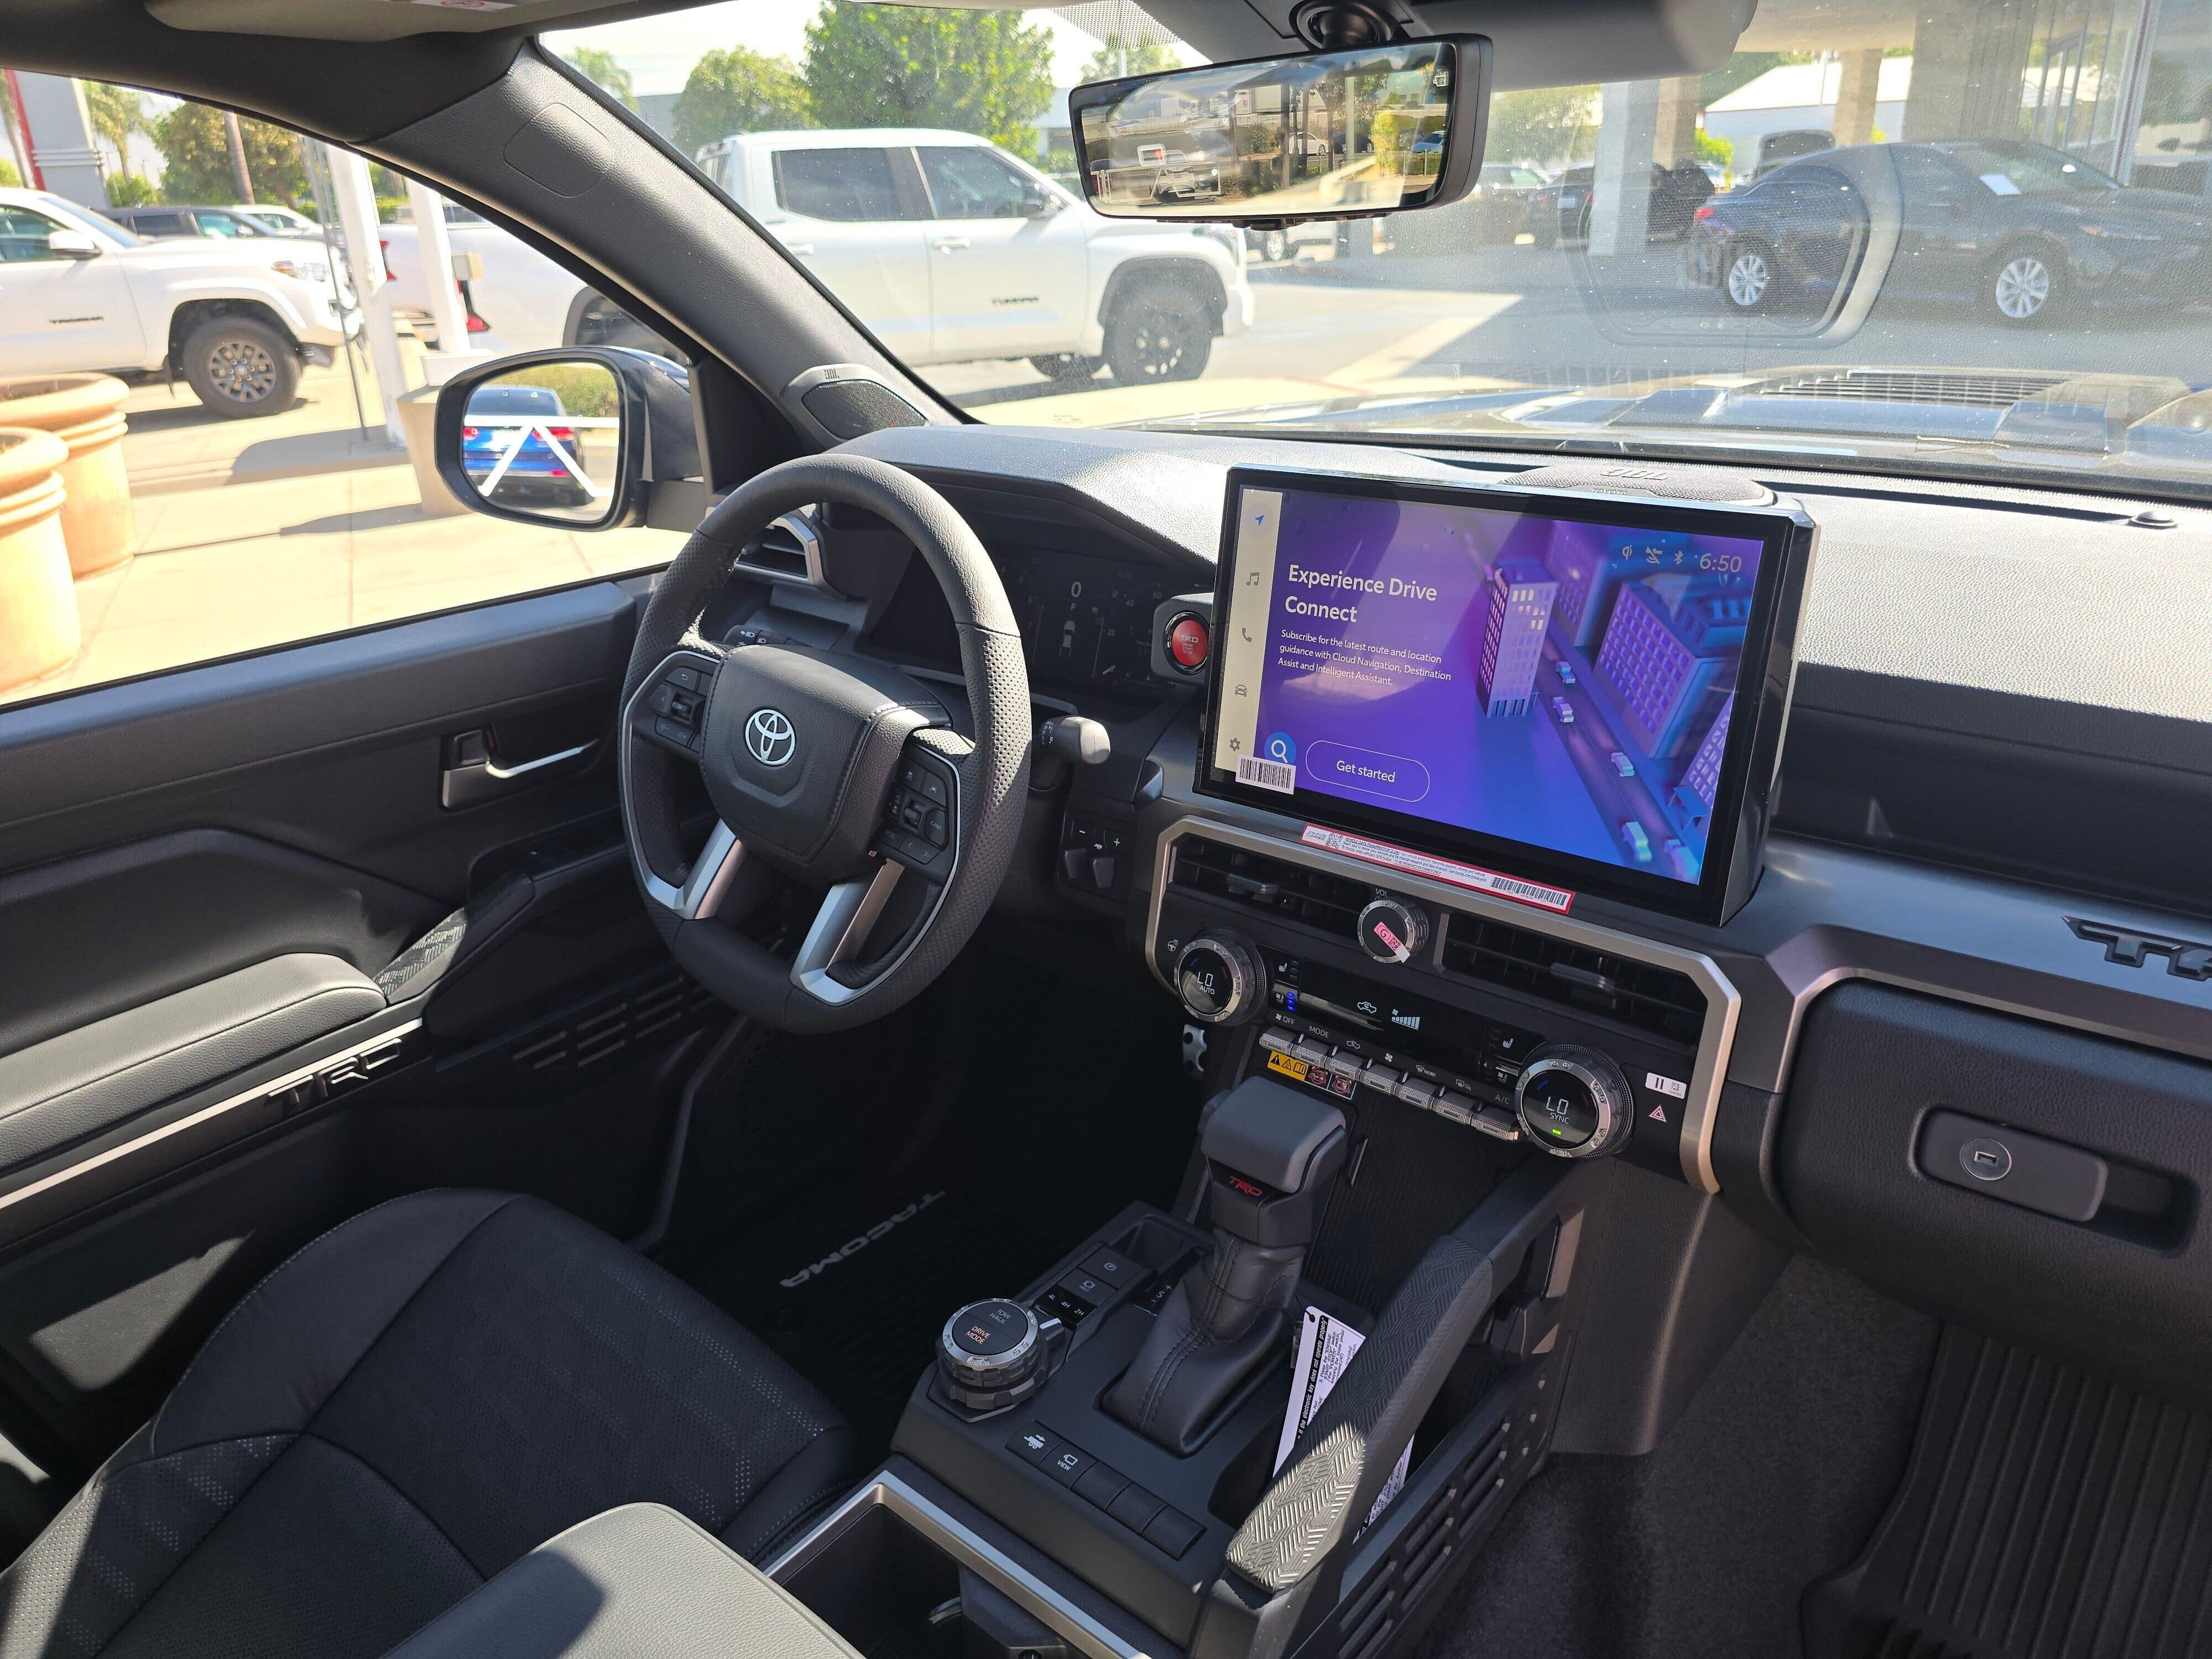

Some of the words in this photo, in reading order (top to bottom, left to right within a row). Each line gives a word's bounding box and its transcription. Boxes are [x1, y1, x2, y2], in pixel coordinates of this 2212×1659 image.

[1699, 553, 1741, 573] 6:50
[1288, 564, 1384, 593] Experience
[1389, 578, 1437, 601] Drive
[1285, 596, 1357, 622] Connect
[1281, 629, 1317, 643] Subscribe
[1318, 635, 1329, 645] for
[1330, 638, 1343, 647] the
[1344, 639, 1366, 651] latest
[1368, 644, 1389, 655] route
[1391, 646, 1406, 658] and
[1408, 650, 1441, 663] location
[1280, 644, 1313, 656] guidance
[1314, 649, 1331, 660] with
[1332, 652, 1355, 664] Cloud
[1358, 657, 1401, 673] Navigation,
[1404, 665, 1451, 681] Destination
[1278, 657, 1299, 669] Assist
[1300, 661, 1314, 672] and
[1316, 665, 1354, 679] Intelligent
[1355, 671, 1393, 686] Assistant.
[1337, 760, 1355, 774] Get
[1358, 766, 1395, 782] started
[1375, 888, 1387, 896] VOL
[1199, 985, 1215, 994] AUTO
[1283, 1016, 1295, 1025] OFF
[1309, 1025, 1328, 1038] MODE
[267, 1037, 403, 1106] TRD
[1495, 1094, 1510, 1105] A/C
[1550, 1112, 1569, 1124] SYNC
[1229, 1175, 1262, 1196] TRD
[997, 1309, 1012, 1319] TOW
[1061, 1301, 1071, 1309] 4H
[1074, 1308, 1084, 1317] 2H
[989, 1313, 1006, 1324] HAUL
[966, 1331, 986, 1345] MODE
[971, 1326, 990, 1338] DRIVE
[1057, 1460, 1071, 1470] VIEW
